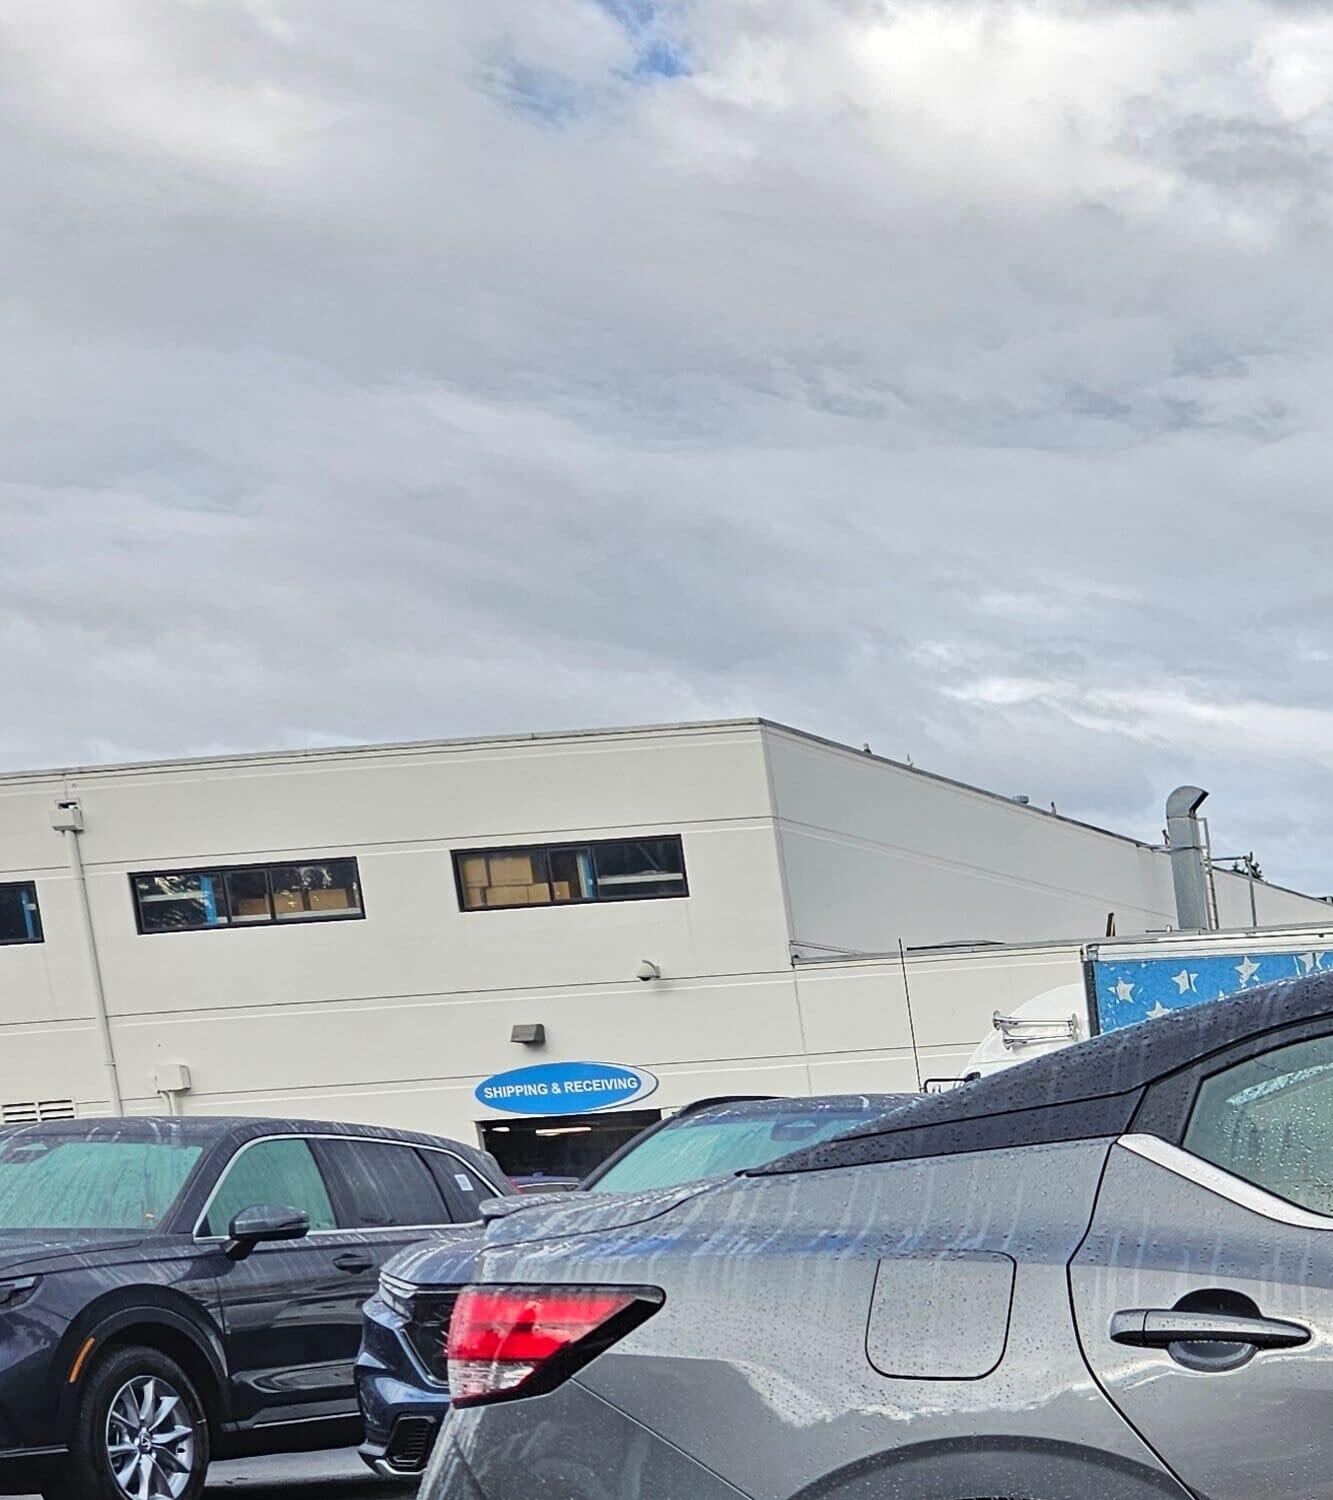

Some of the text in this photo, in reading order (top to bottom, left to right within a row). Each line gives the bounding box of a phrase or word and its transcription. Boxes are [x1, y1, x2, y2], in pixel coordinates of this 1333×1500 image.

[484, 1077, 638, 1099] SHIPPING & RECEIVING
